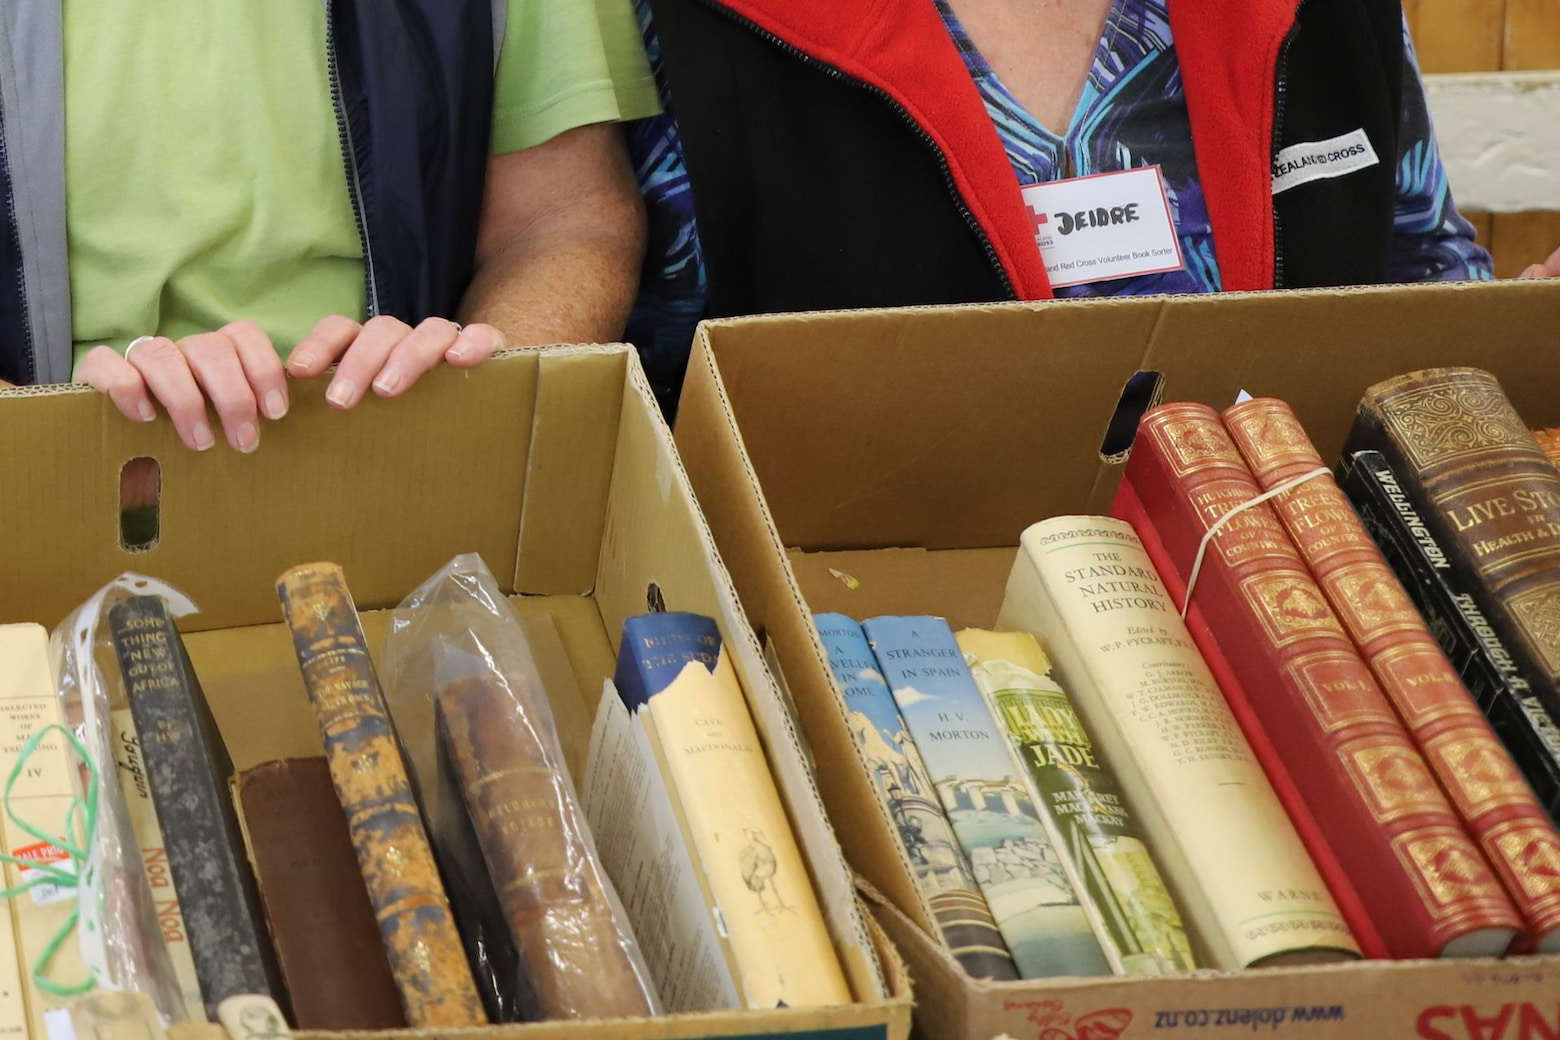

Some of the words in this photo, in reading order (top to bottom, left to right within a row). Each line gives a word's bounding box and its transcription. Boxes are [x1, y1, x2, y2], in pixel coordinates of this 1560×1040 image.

[1328, 144, 1365, 162] CROSS
[1076, 259, 1097, 268] Cross
[1098, 254, 1131, 263] Volunteer
[1132, 250, 1150, 259] Book
[1151, 247, 1173, 256] Sorter
[1447, 498, 1515, 531] LIVE
[1537, 529, 1550, 537] &
[1093, 553, 1122, 561] THE
[1065, 565, 1158, 583] STANDARD
[1375, 469, 1450, 569] WELLINGTON
[1455, 592, 1518, 673] THROUGH
[1079, 582, 1163, 598] NATURAL
[1092, 598, 1167, 613] HISTORY
[121, 632, 166, 646] THING
[820, 629, 860, 638] MORTON
[911, 630, 920, 638] A
[130, 647, 166, 660] NEW
[886, 648, 958, 659] STRANGER
[842, 673, 857, 682] IN
[901, 670, 917, 679] IN
[924, 668, 961, 677] SPAIN
[133, 678, 179, 693] AFRICA
[842, 687, 876, 697] OME
[696, 718, 724, 726] CAVE
[929, 730, 989, 742] MORTON
[1030, 744, 1099, 768] JADE
[28, 768, 42, 777] IV
[142, 848, 169, 888] Noa
[156, 900, 184, 942] Noa
[1155, 1006, 1344, 1029] www.dolenz.co.nz
